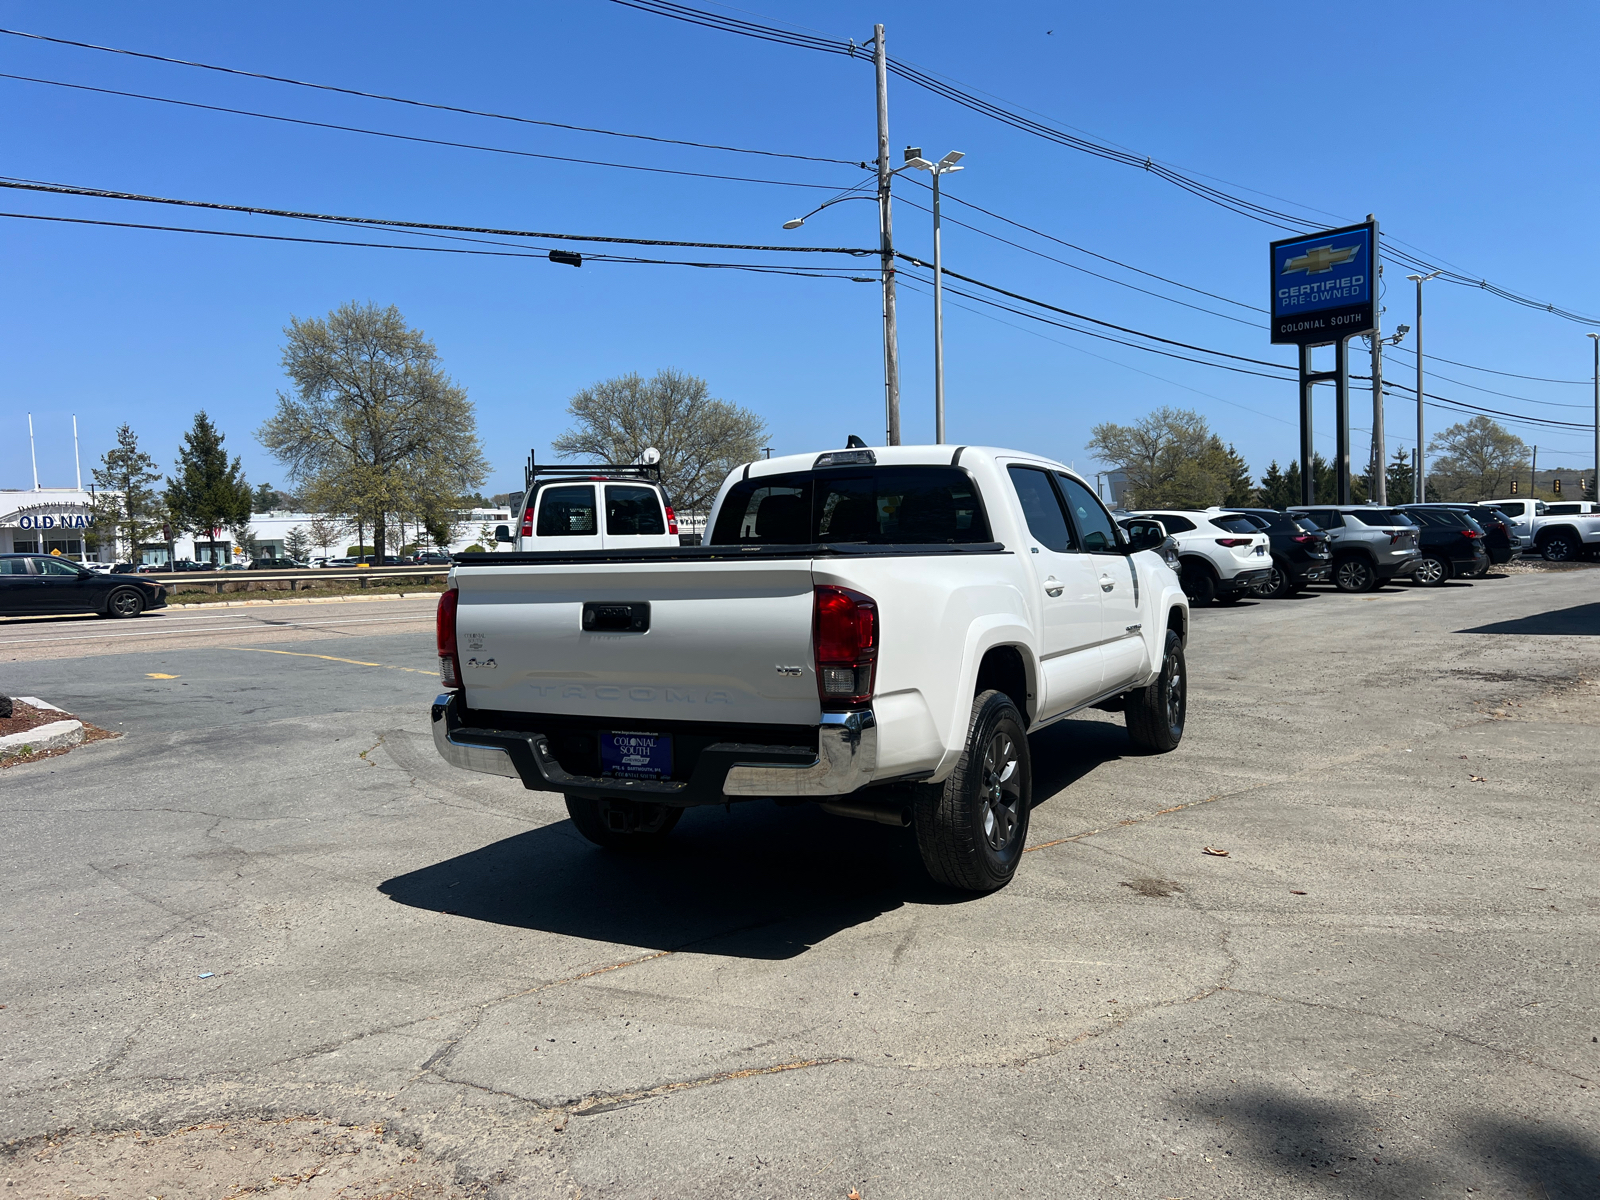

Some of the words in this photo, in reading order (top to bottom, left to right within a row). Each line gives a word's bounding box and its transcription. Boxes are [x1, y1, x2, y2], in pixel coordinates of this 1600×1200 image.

[1278, 275, 1364, 298] CERTIFIED
[1282, 286, 1360, 307] PRE-OWNED
[1281, 319, 1326, 333] COLONIAL
[1331, 313, 1362, 326] SOUTH
[18, 501, 76, 513] DARTMOUTH
[20, 515, 55, 530] OLD
[60, 515, 96, 529] NAV
[529, 683, 735, 705] TACOMA
[613, 736, 657, 747] COLONIAL
[620, 745, 651, 755] SOUTH
